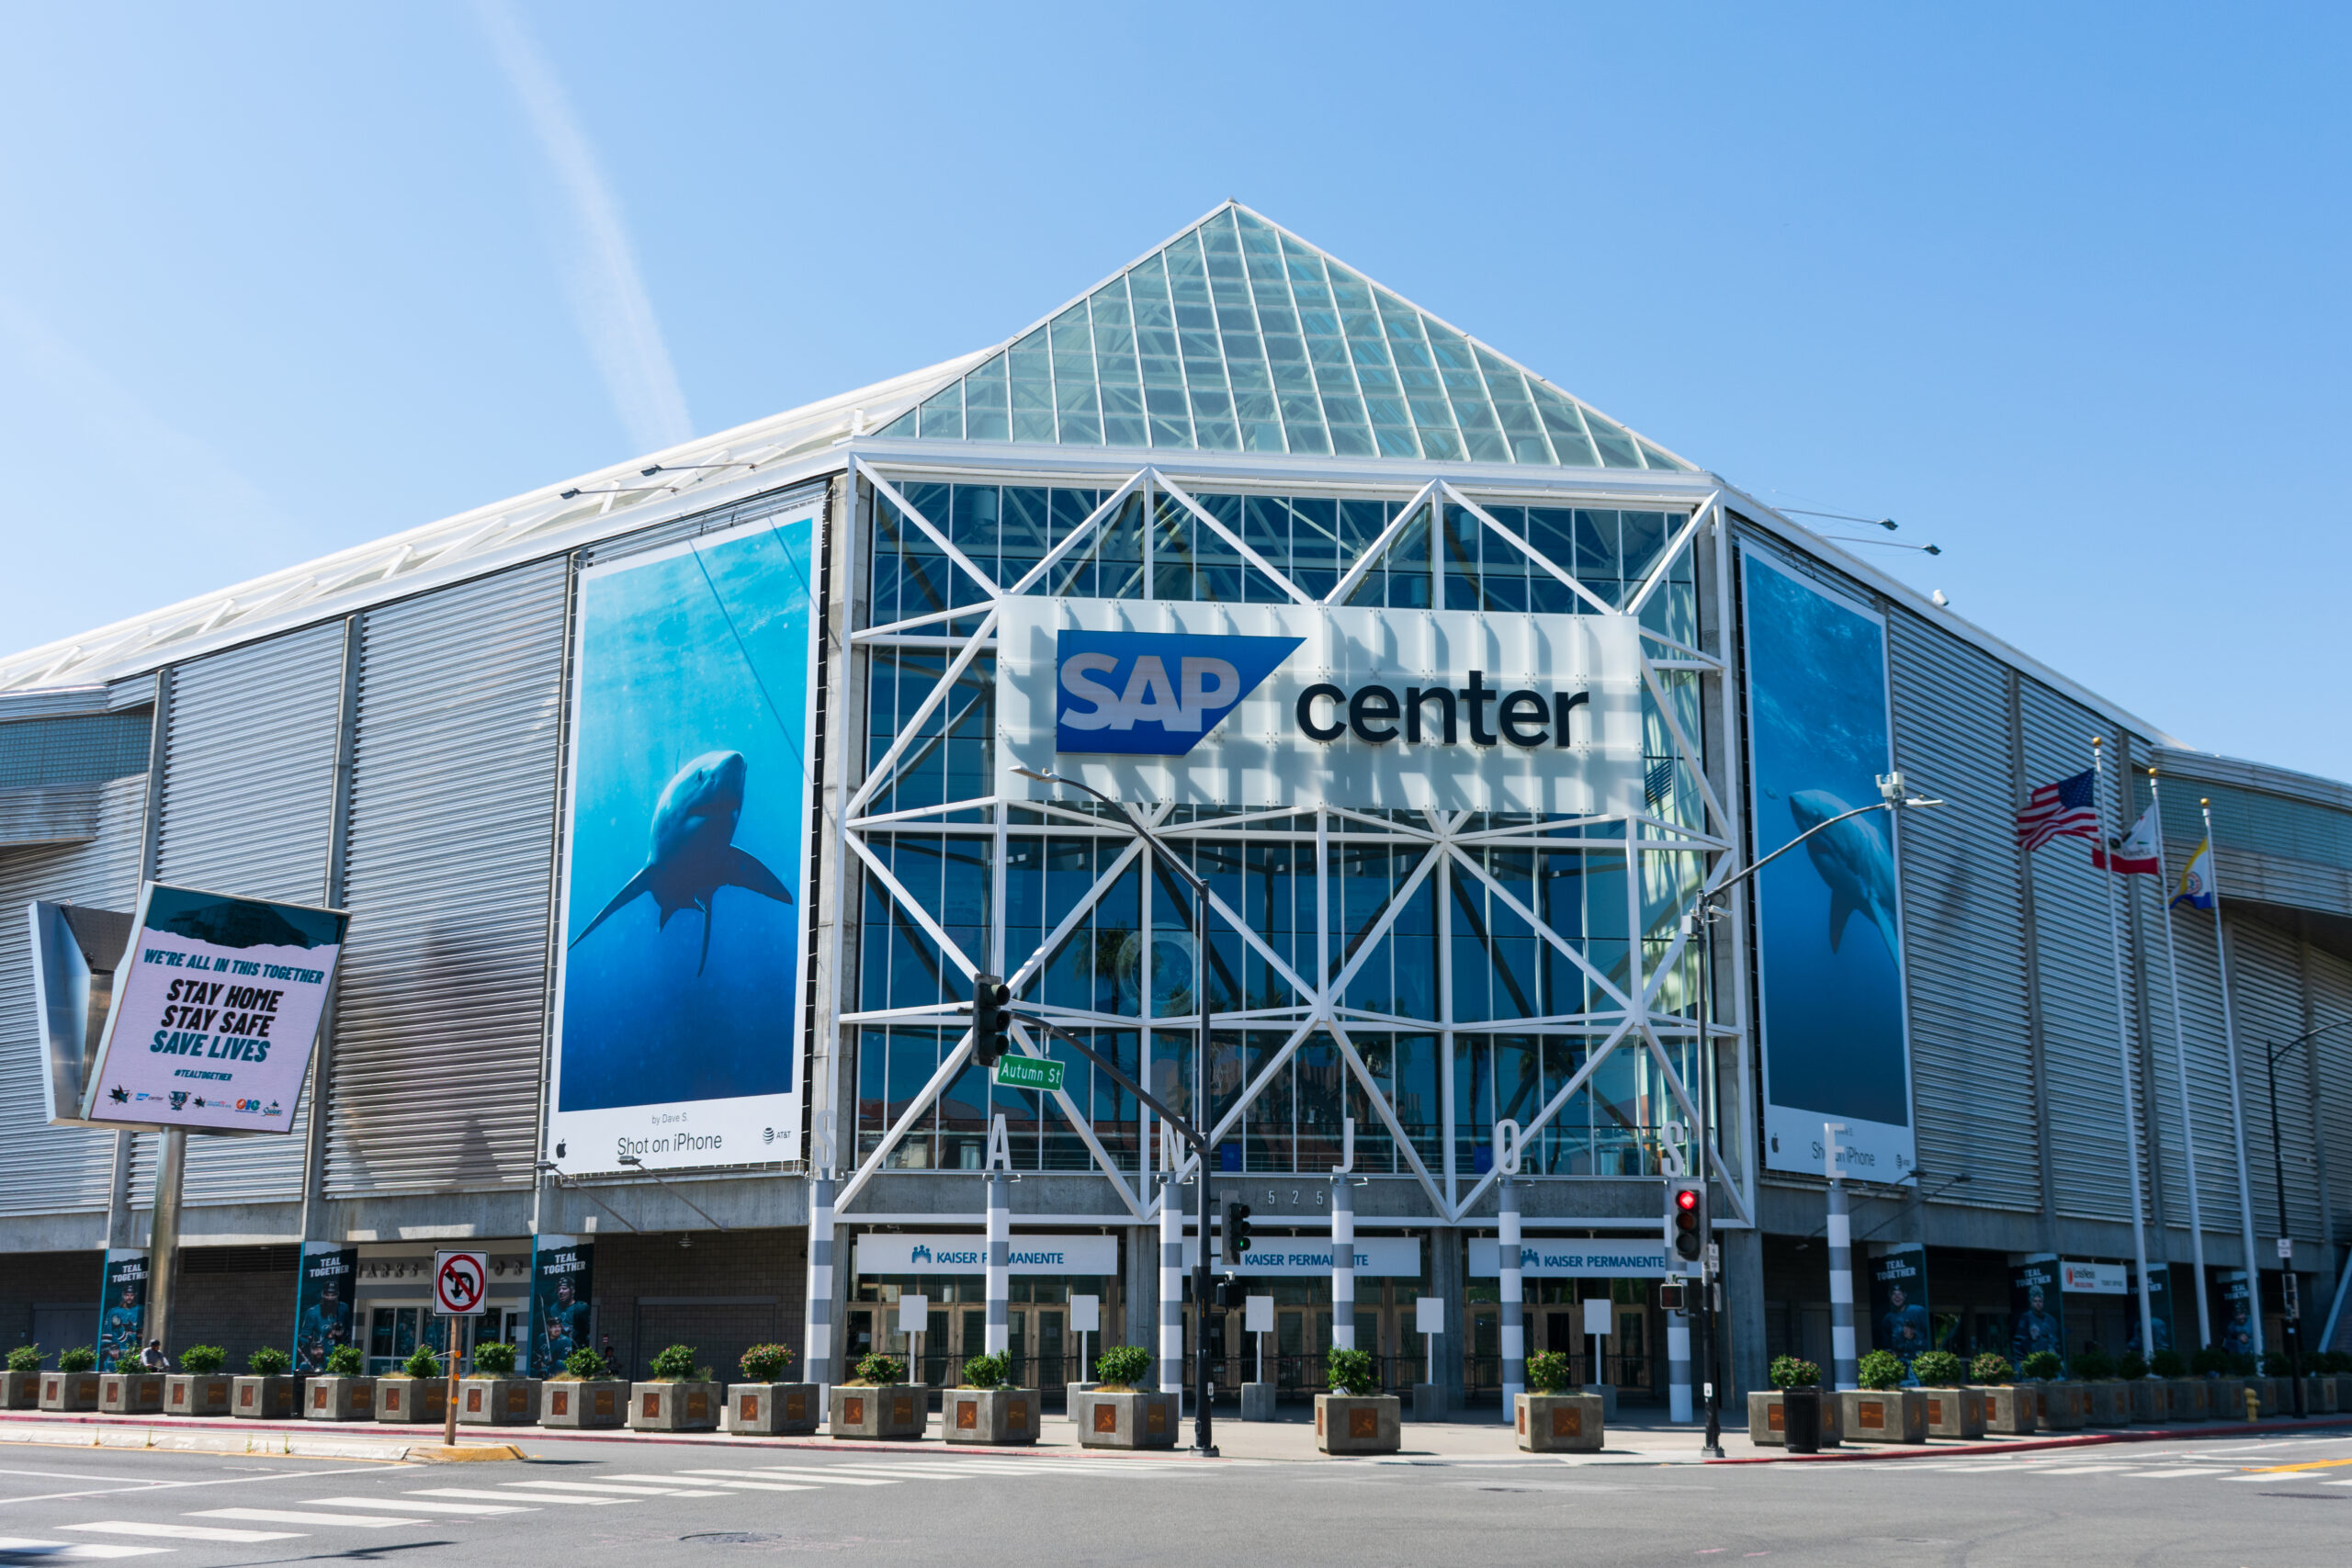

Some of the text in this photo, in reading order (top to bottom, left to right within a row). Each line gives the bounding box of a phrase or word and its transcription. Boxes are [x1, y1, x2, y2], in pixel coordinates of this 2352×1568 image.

[1059, 652, 1589, 750] SAP center
[143, 949, 325, 984] WE'RE ALL IN THIS TOGETHER
[166, 978, 285, 1012] STAY HOME
[161, 1005, 276, 1037] STAY SAFE
[150, 1030, 271, 1063] SAVE LIVES
[174, 1069, 232, 1081] #TEALTOGETHER
[1001, 1062, 1061, 1084] Autumn St
[651, 1114, 661, 1125] by
[662, 1113, 680, 1124] Dave
[776, 1131, 791, 1139] AT&T
[617, 1133, 722, 1155] Shot on iPhone
[1846, 1145, 1875, 1167] iPhone
[320, 1257, 341, 1267] TEAL
[555, 1252, 577, 1263] TEAL
[936, 1252, 978, 1264] KAISER
[1244, 1254, 1284, 1266] KAISER
[1544, 1256, 1665, 1268] KAISER PERMANENTE
[122, 1264, 142, 1273] TEAL
[544, 1261, 586, 1275] TOGETHER
[1885, 1259, 1905, 1269] TEAL
[112, 1271, 149, 1282] TOGETHE
[310, 1265, 349, 1278] TOGETHER
[1877, 1267, 1917, 1280] TOGETHER
